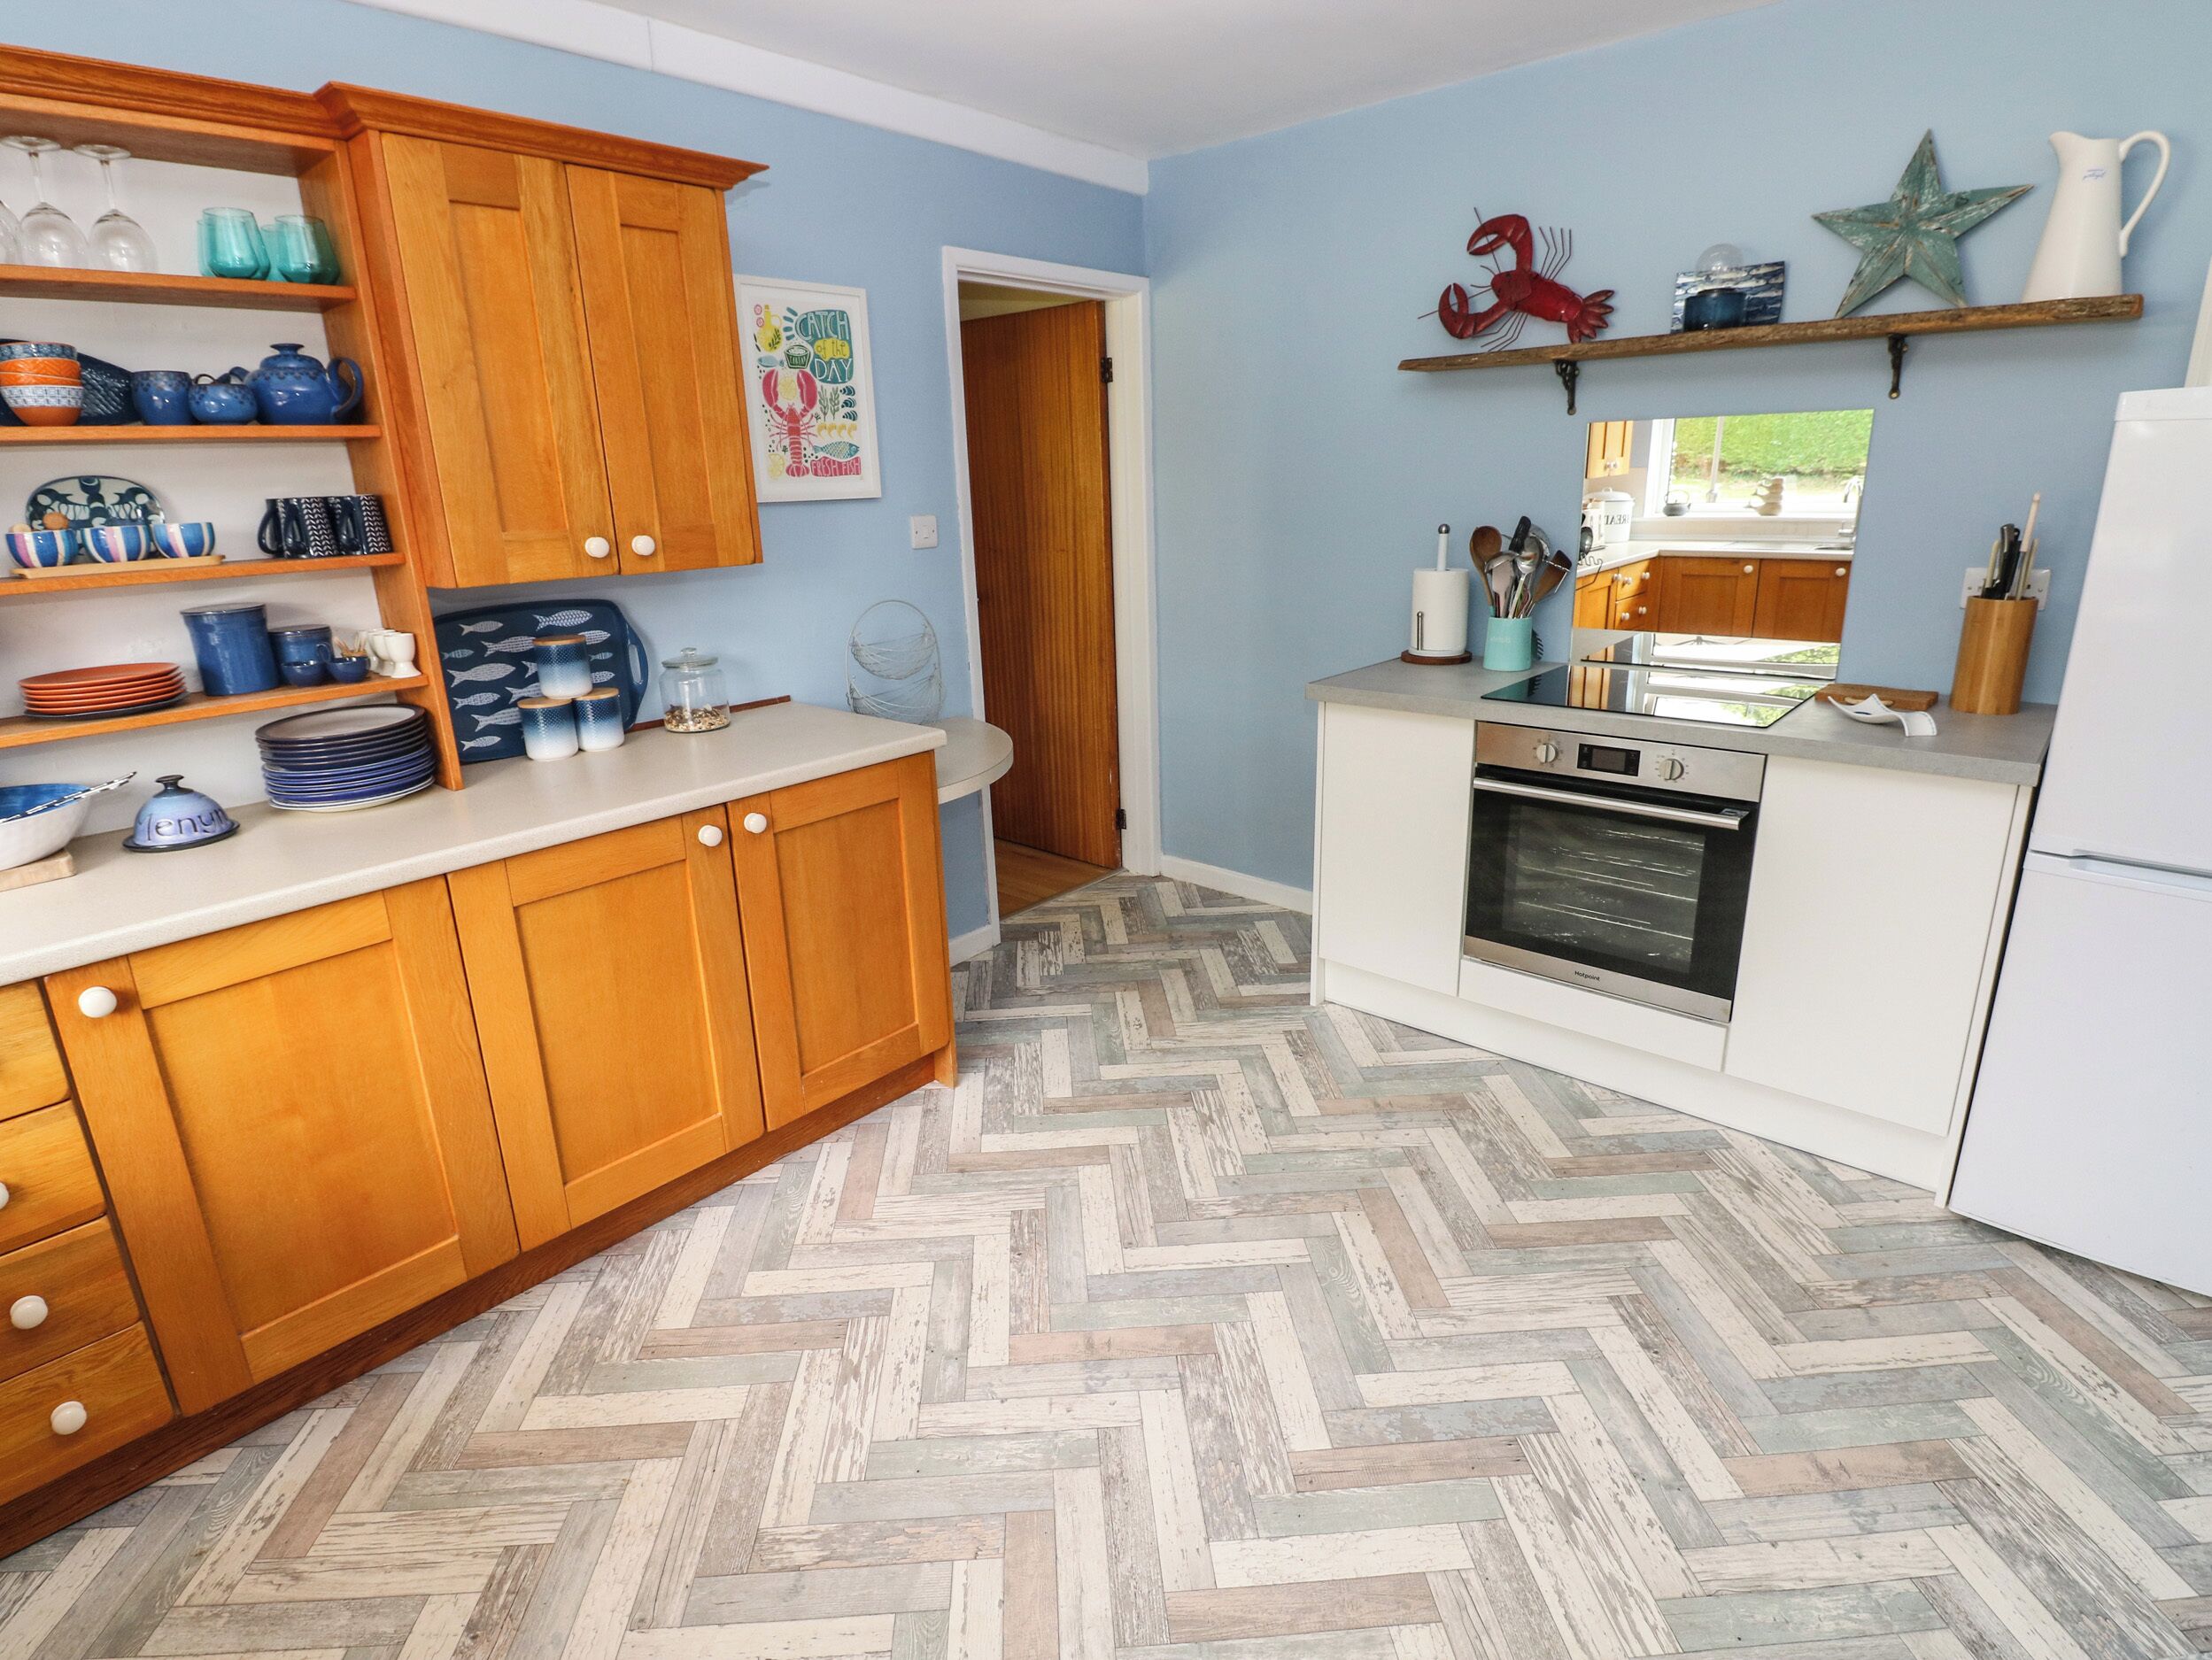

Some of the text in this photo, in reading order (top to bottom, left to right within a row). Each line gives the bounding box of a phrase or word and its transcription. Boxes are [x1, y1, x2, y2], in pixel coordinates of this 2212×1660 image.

[795, 311, 849, 341] CATCH
[816, 340, 847, 359] of the
[815, 359, 852, 382] DAY
[812, 457, 861, 475] FRESH FISH
[1574, 970, 1600, 982] Hotpoint
